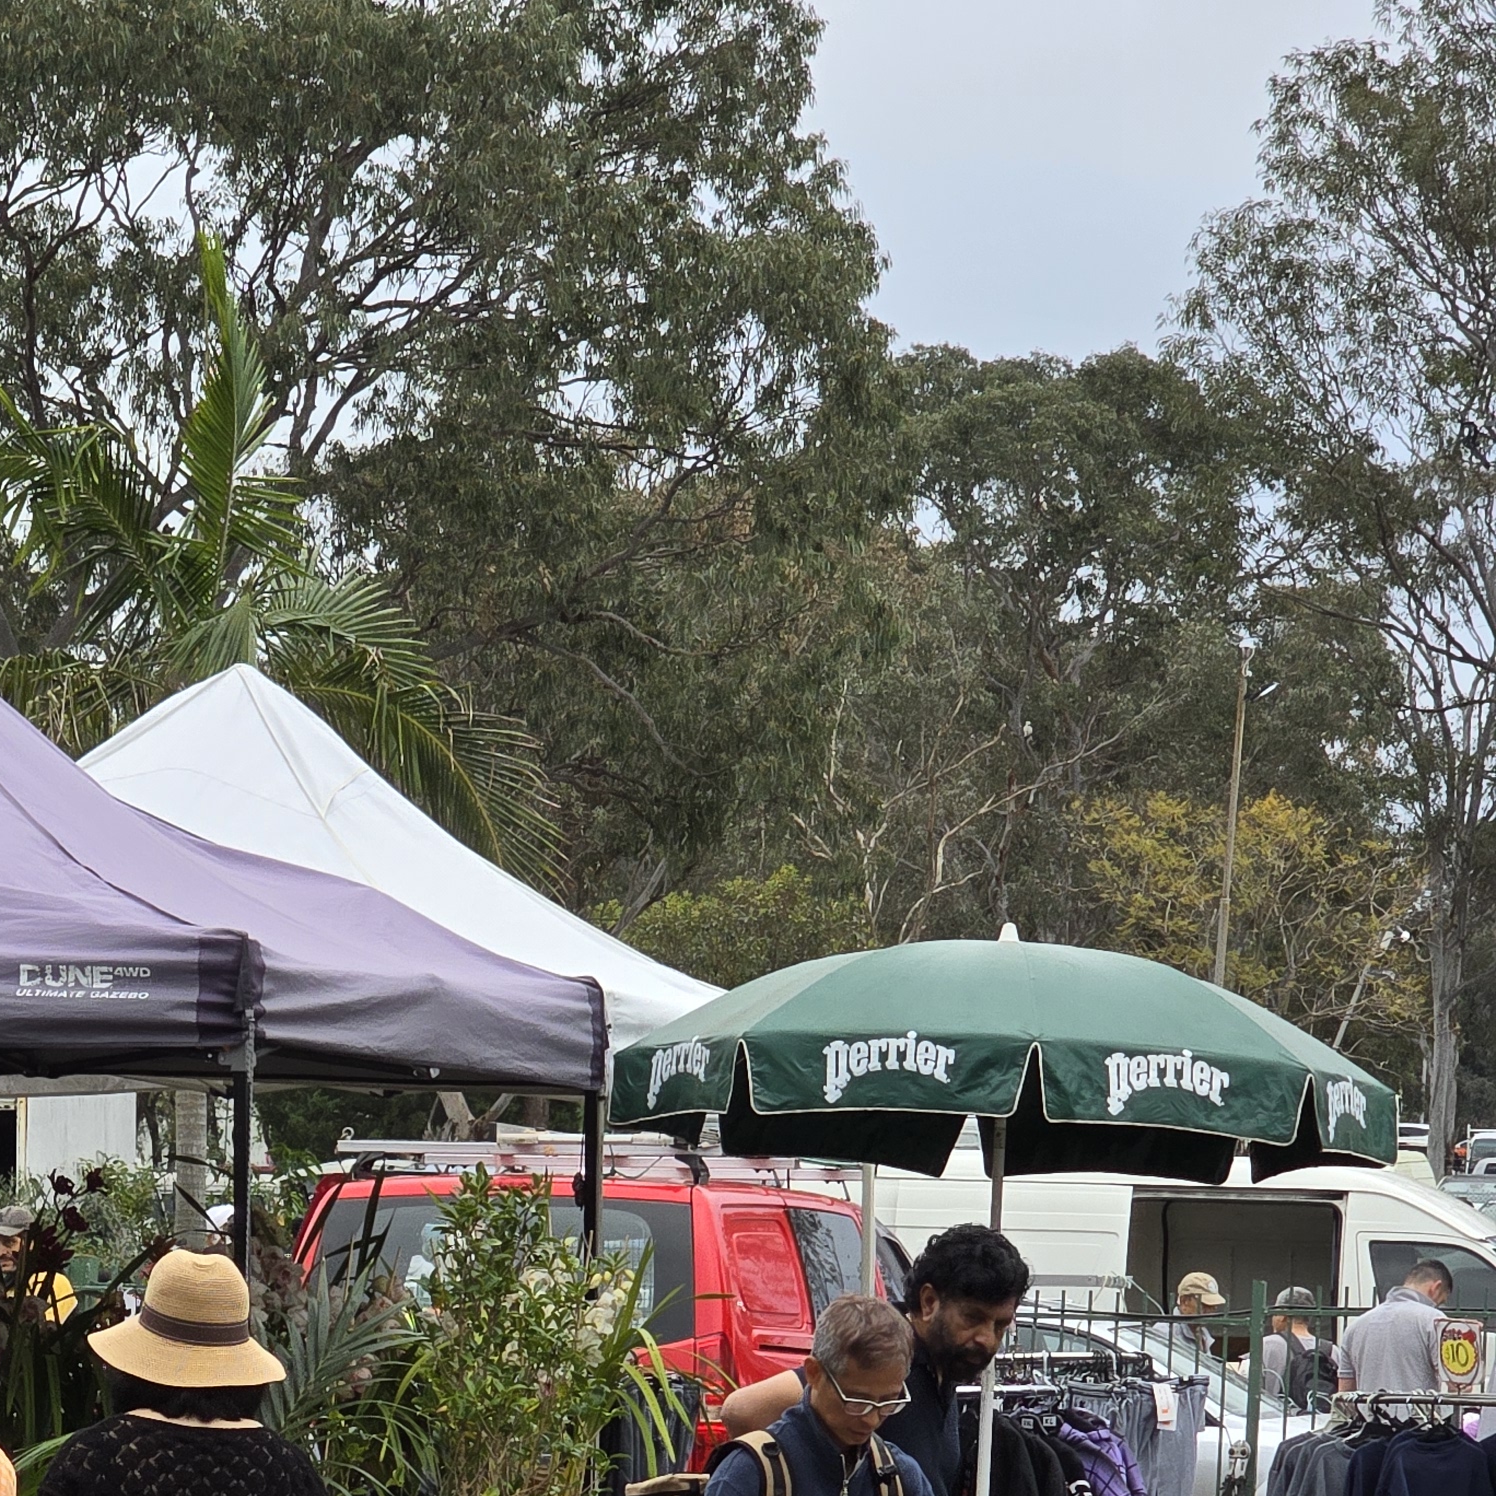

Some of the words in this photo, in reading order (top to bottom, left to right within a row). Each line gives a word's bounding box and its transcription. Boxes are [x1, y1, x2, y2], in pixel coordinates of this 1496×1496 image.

[19, 963, 113, 988] DUNE
[113, 966, 151, 977] 4WD
[15, 988, 85, 997] ULTIMATE
[90, 990, 149, 999] GAZEBO
[1444, 1342, 1470, 1367] $10
